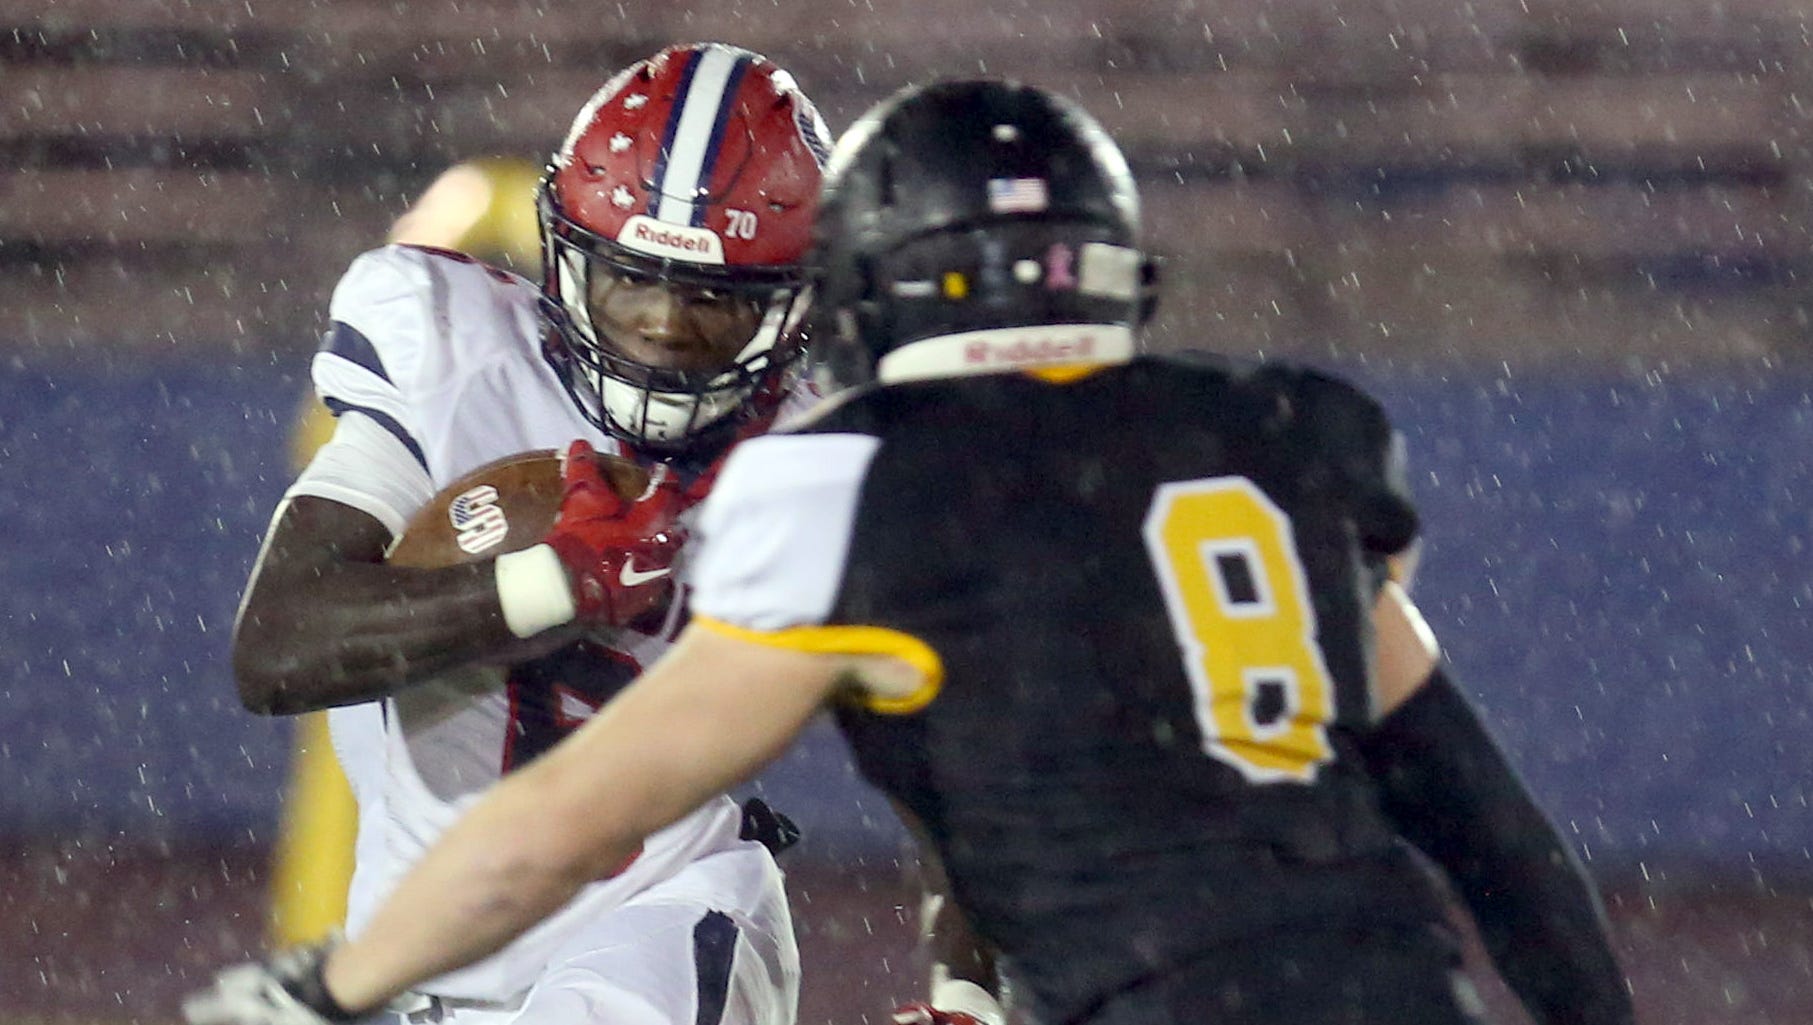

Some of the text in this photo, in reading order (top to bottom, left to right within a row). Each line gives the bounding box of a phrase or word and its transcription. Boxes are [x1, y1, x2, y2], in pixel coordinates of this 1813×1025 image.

[635, 223, 710, 254] Riddell
[724, 207, 758, 241] 70
[448, 484, 510, 555] S
[1142, 475, 1336, 785] 8
